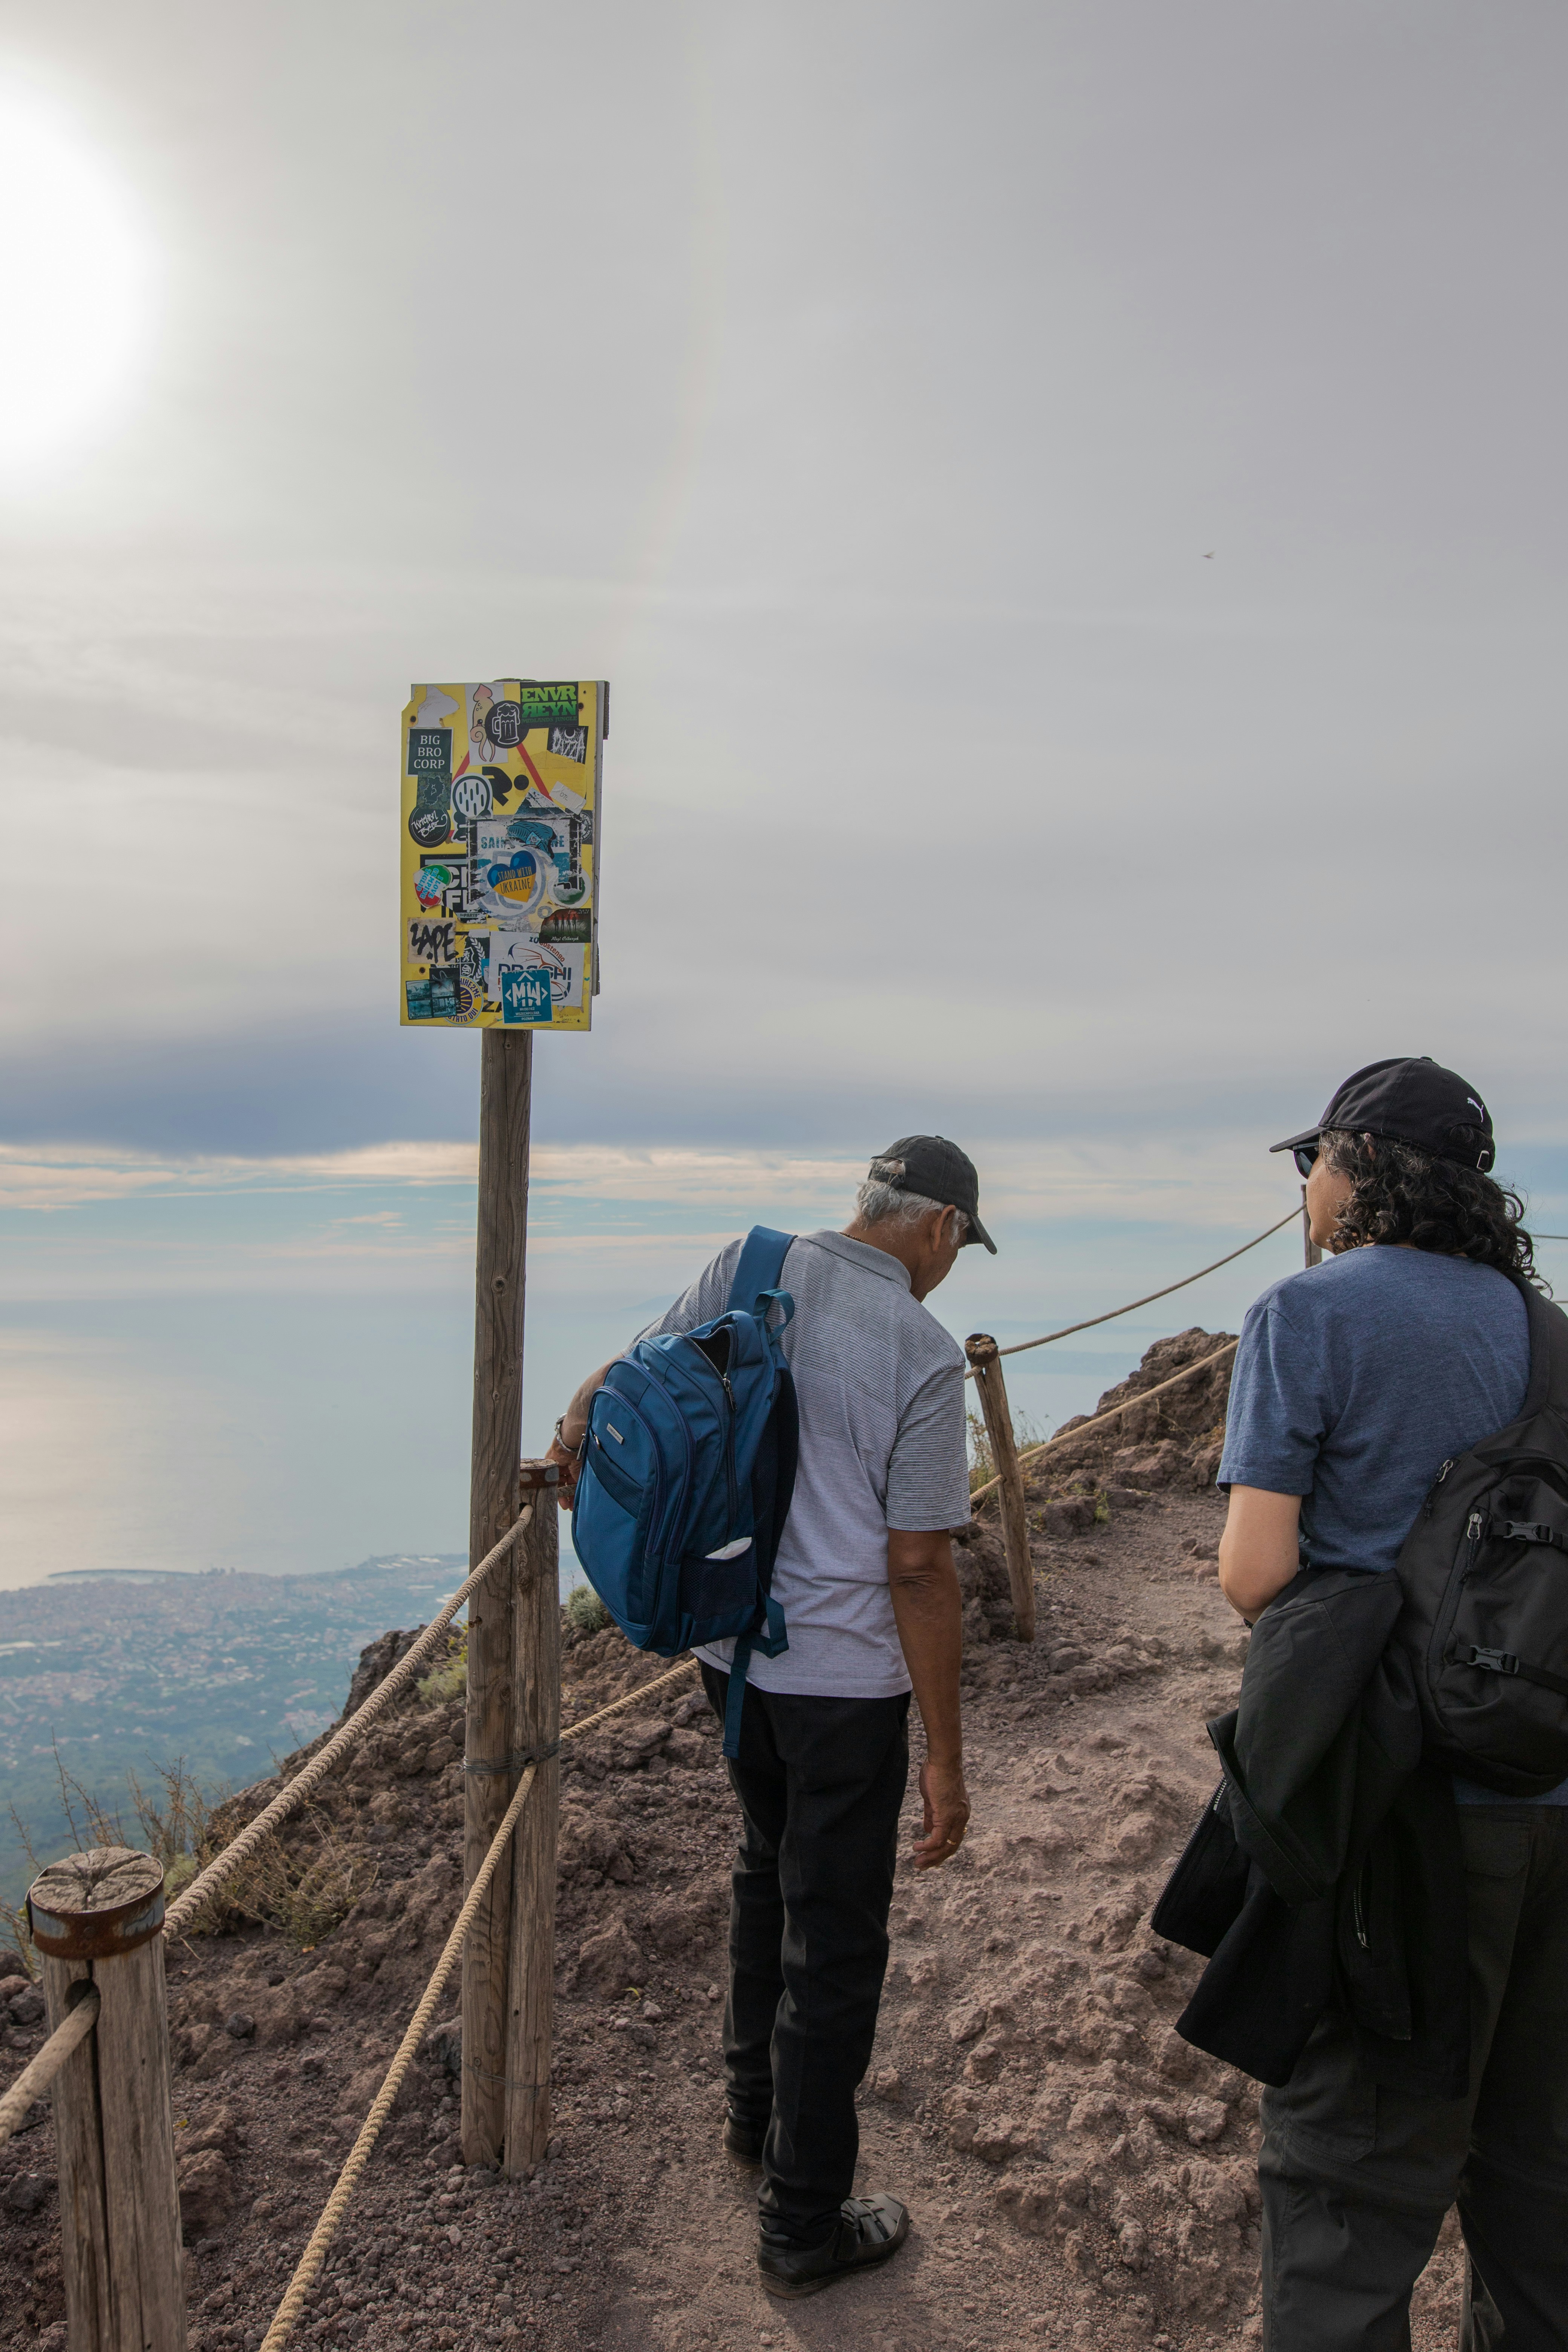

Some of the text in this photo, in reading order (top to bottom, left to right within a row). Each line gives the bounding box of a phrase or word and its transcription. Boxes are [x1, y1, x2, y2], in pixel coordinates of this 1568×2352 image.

[521, 685, 576, 702] ENVR
[420, 735, 440, 744] BIG
[418, 747, 441, 756] BRO
[414, 760, 445, 769] CORP
[416, 868, 431, 891] TIGLIO
[498, 866, 532, 881] STAND WITH
[420, 868, 439, 899] CAMPING
[428, 880, 441, 899] LOVE
[500, 878, 531, 894] UKRAINE
[468, 1008, 478, 1020] QUI
